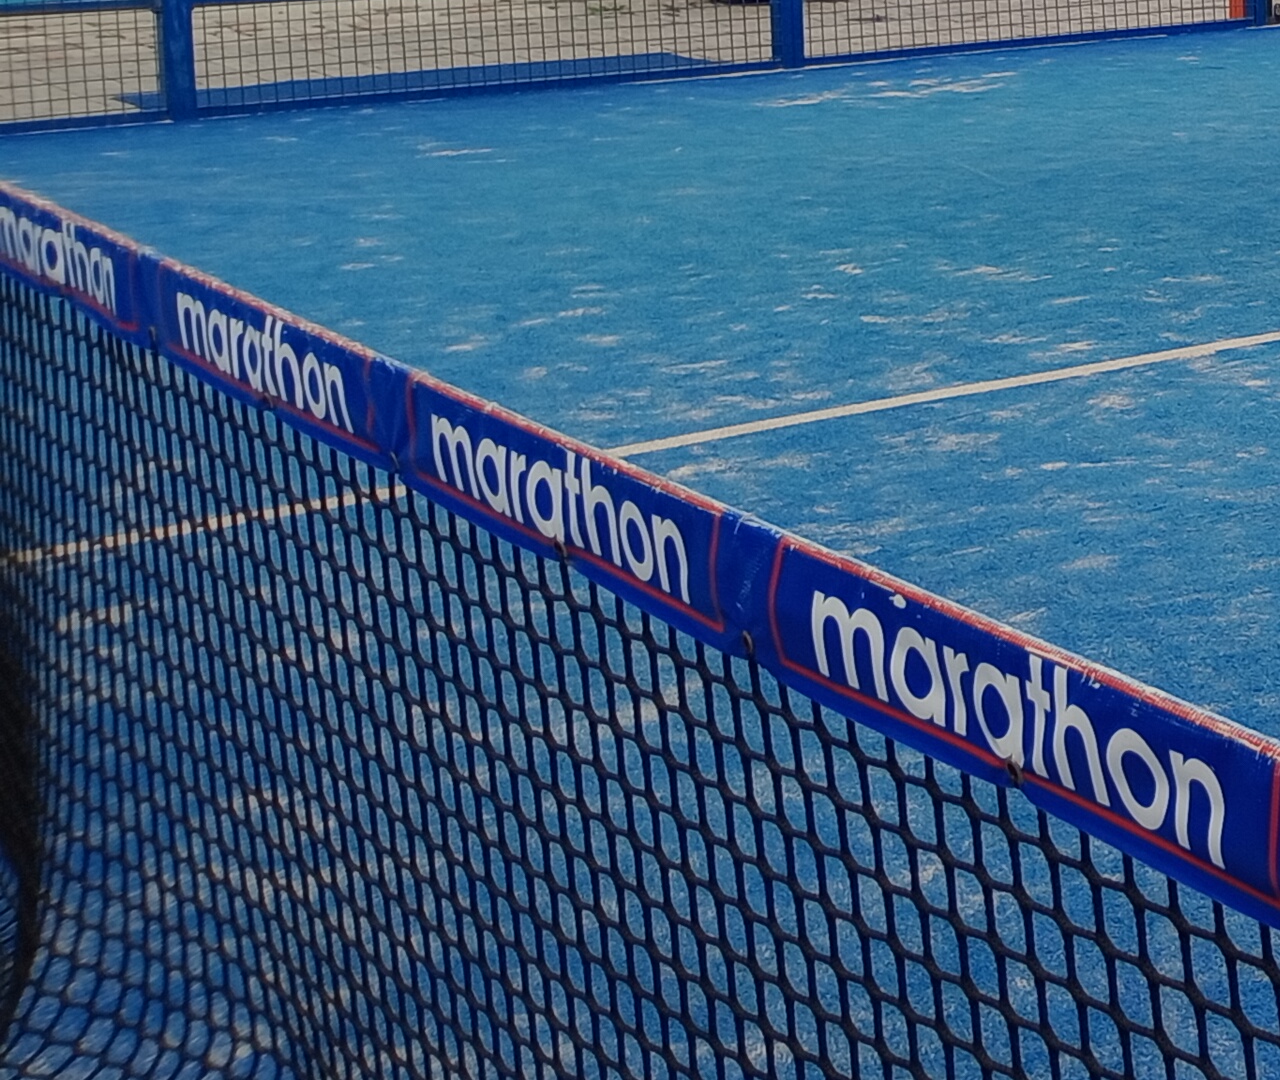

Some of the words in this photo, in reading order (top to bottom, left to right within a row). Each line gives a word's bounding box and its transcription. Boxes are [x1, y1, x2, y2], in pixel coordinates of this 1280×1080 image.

[0, 206, 117, 317] marathon
[176, 291, 355, 434] marathon
[430, 413, 692, 605] marathon
[810, 589, 1227, 871] marathon
